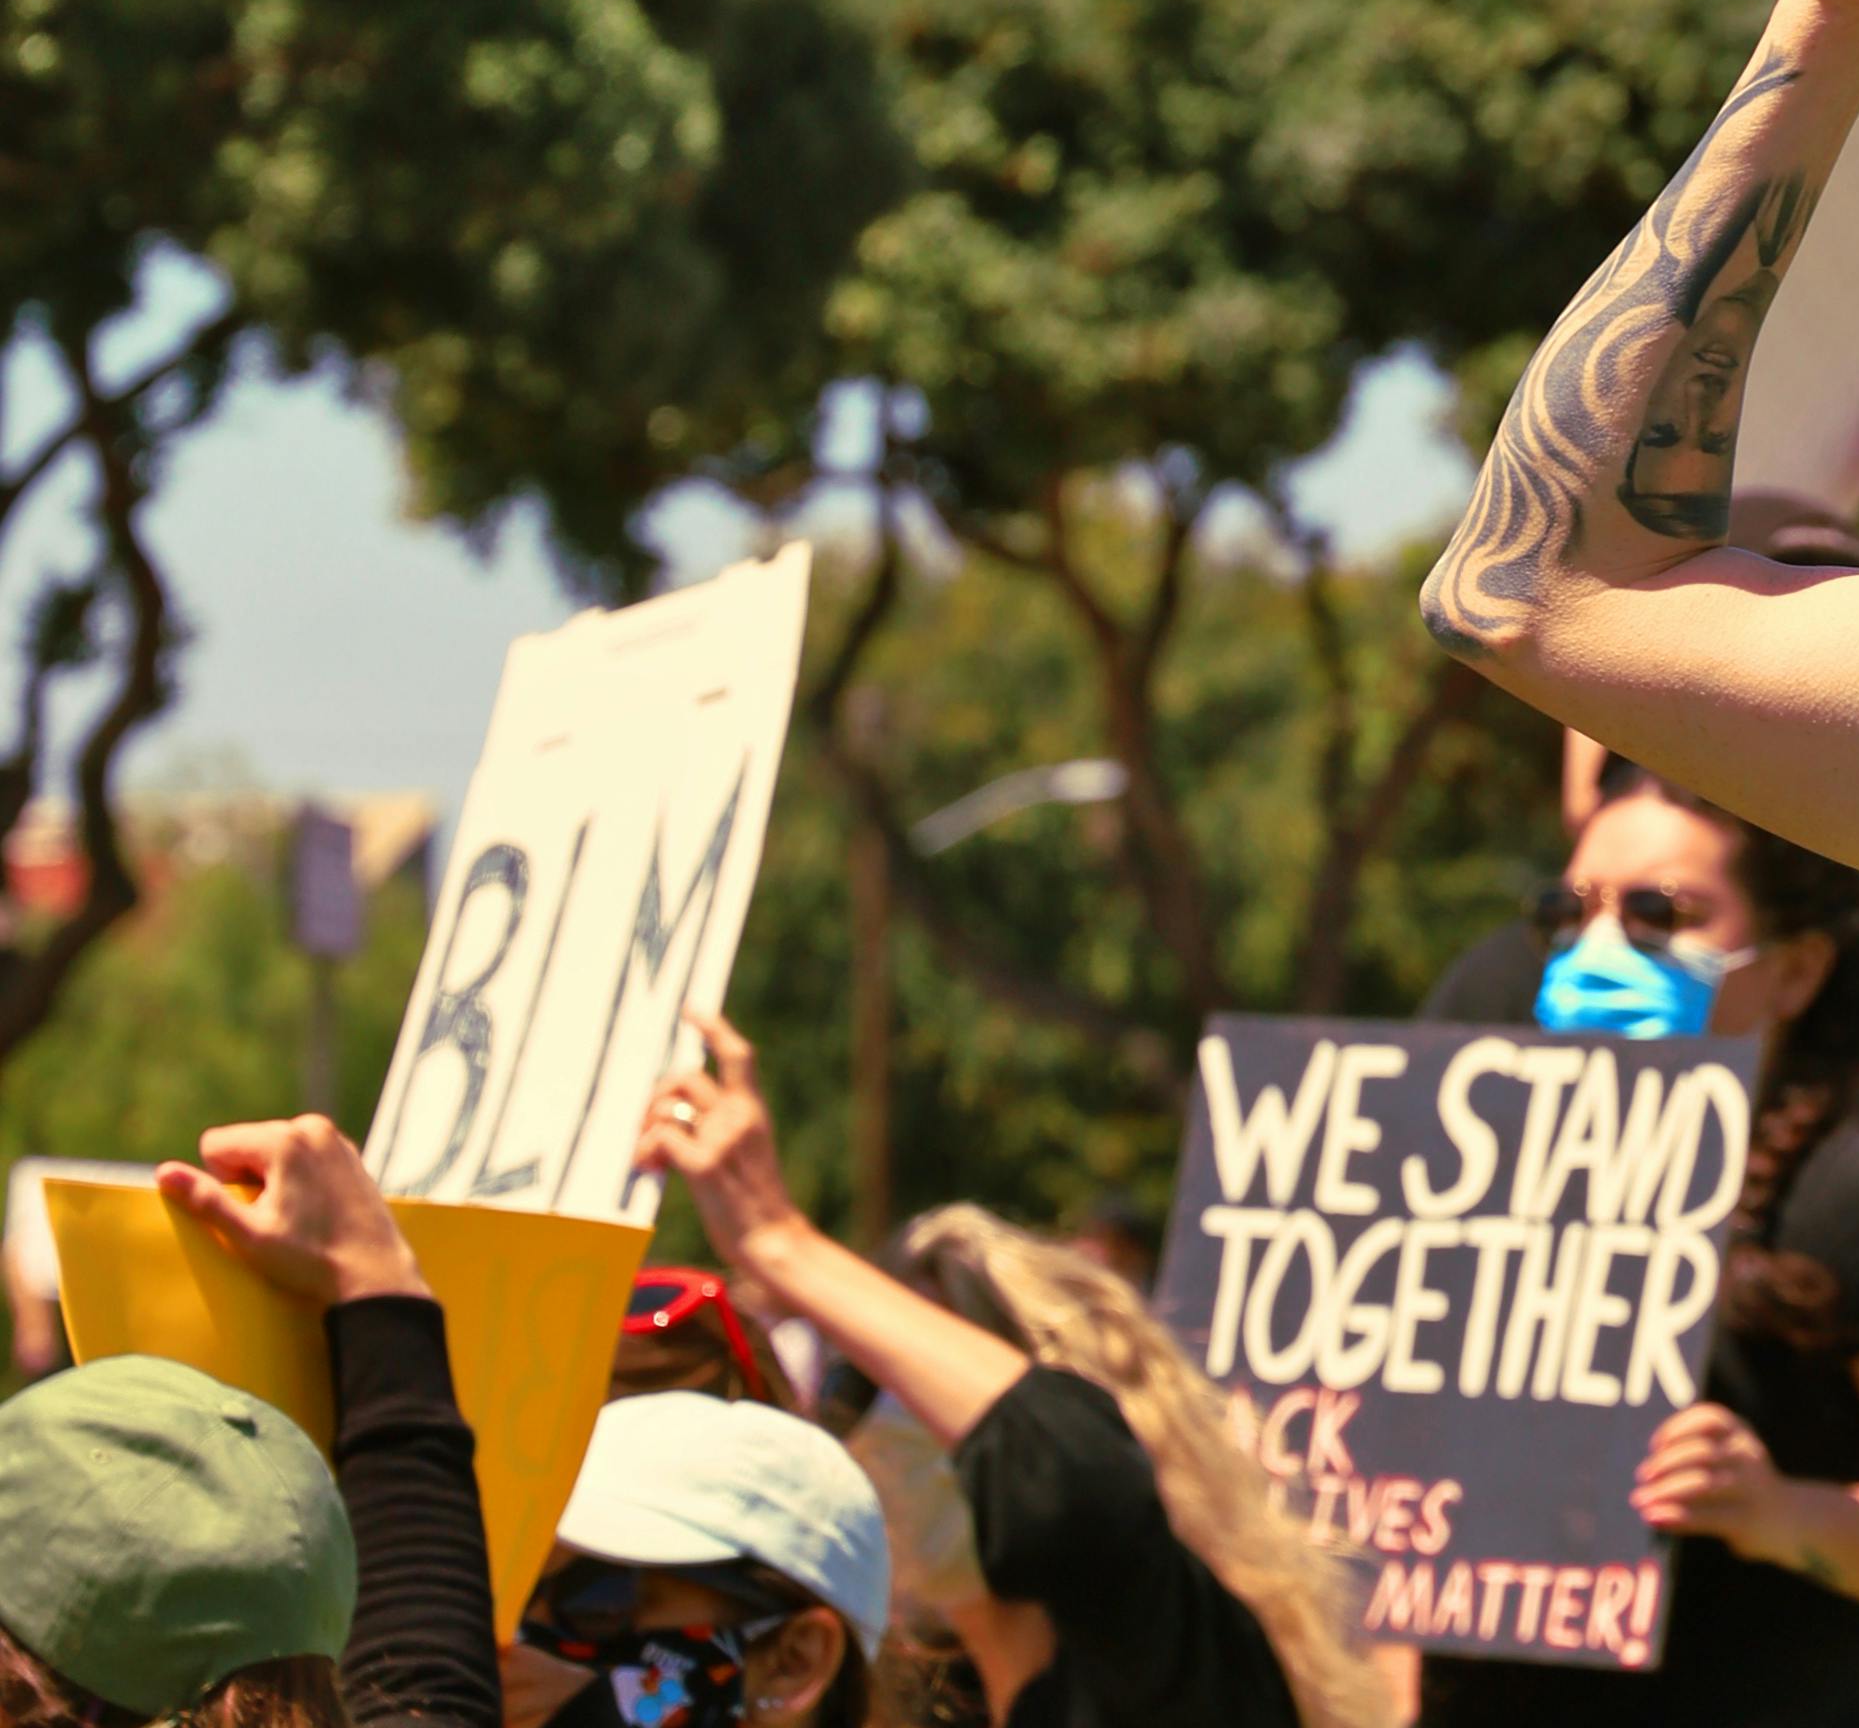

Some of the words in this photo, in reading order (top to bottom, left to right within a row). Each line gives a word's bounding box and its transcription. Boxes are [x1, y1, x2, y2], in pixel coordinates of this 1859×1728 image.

[1198, 1035, 1408, 1216] WE
[1401, 1035, 1751, 1235] STAND
[1200, 1206, 1720, 1409] TOGETHER
[1226, 1385, 1362, 1476] CK
[1364, 1559, 1661, 1667] MATTER!
